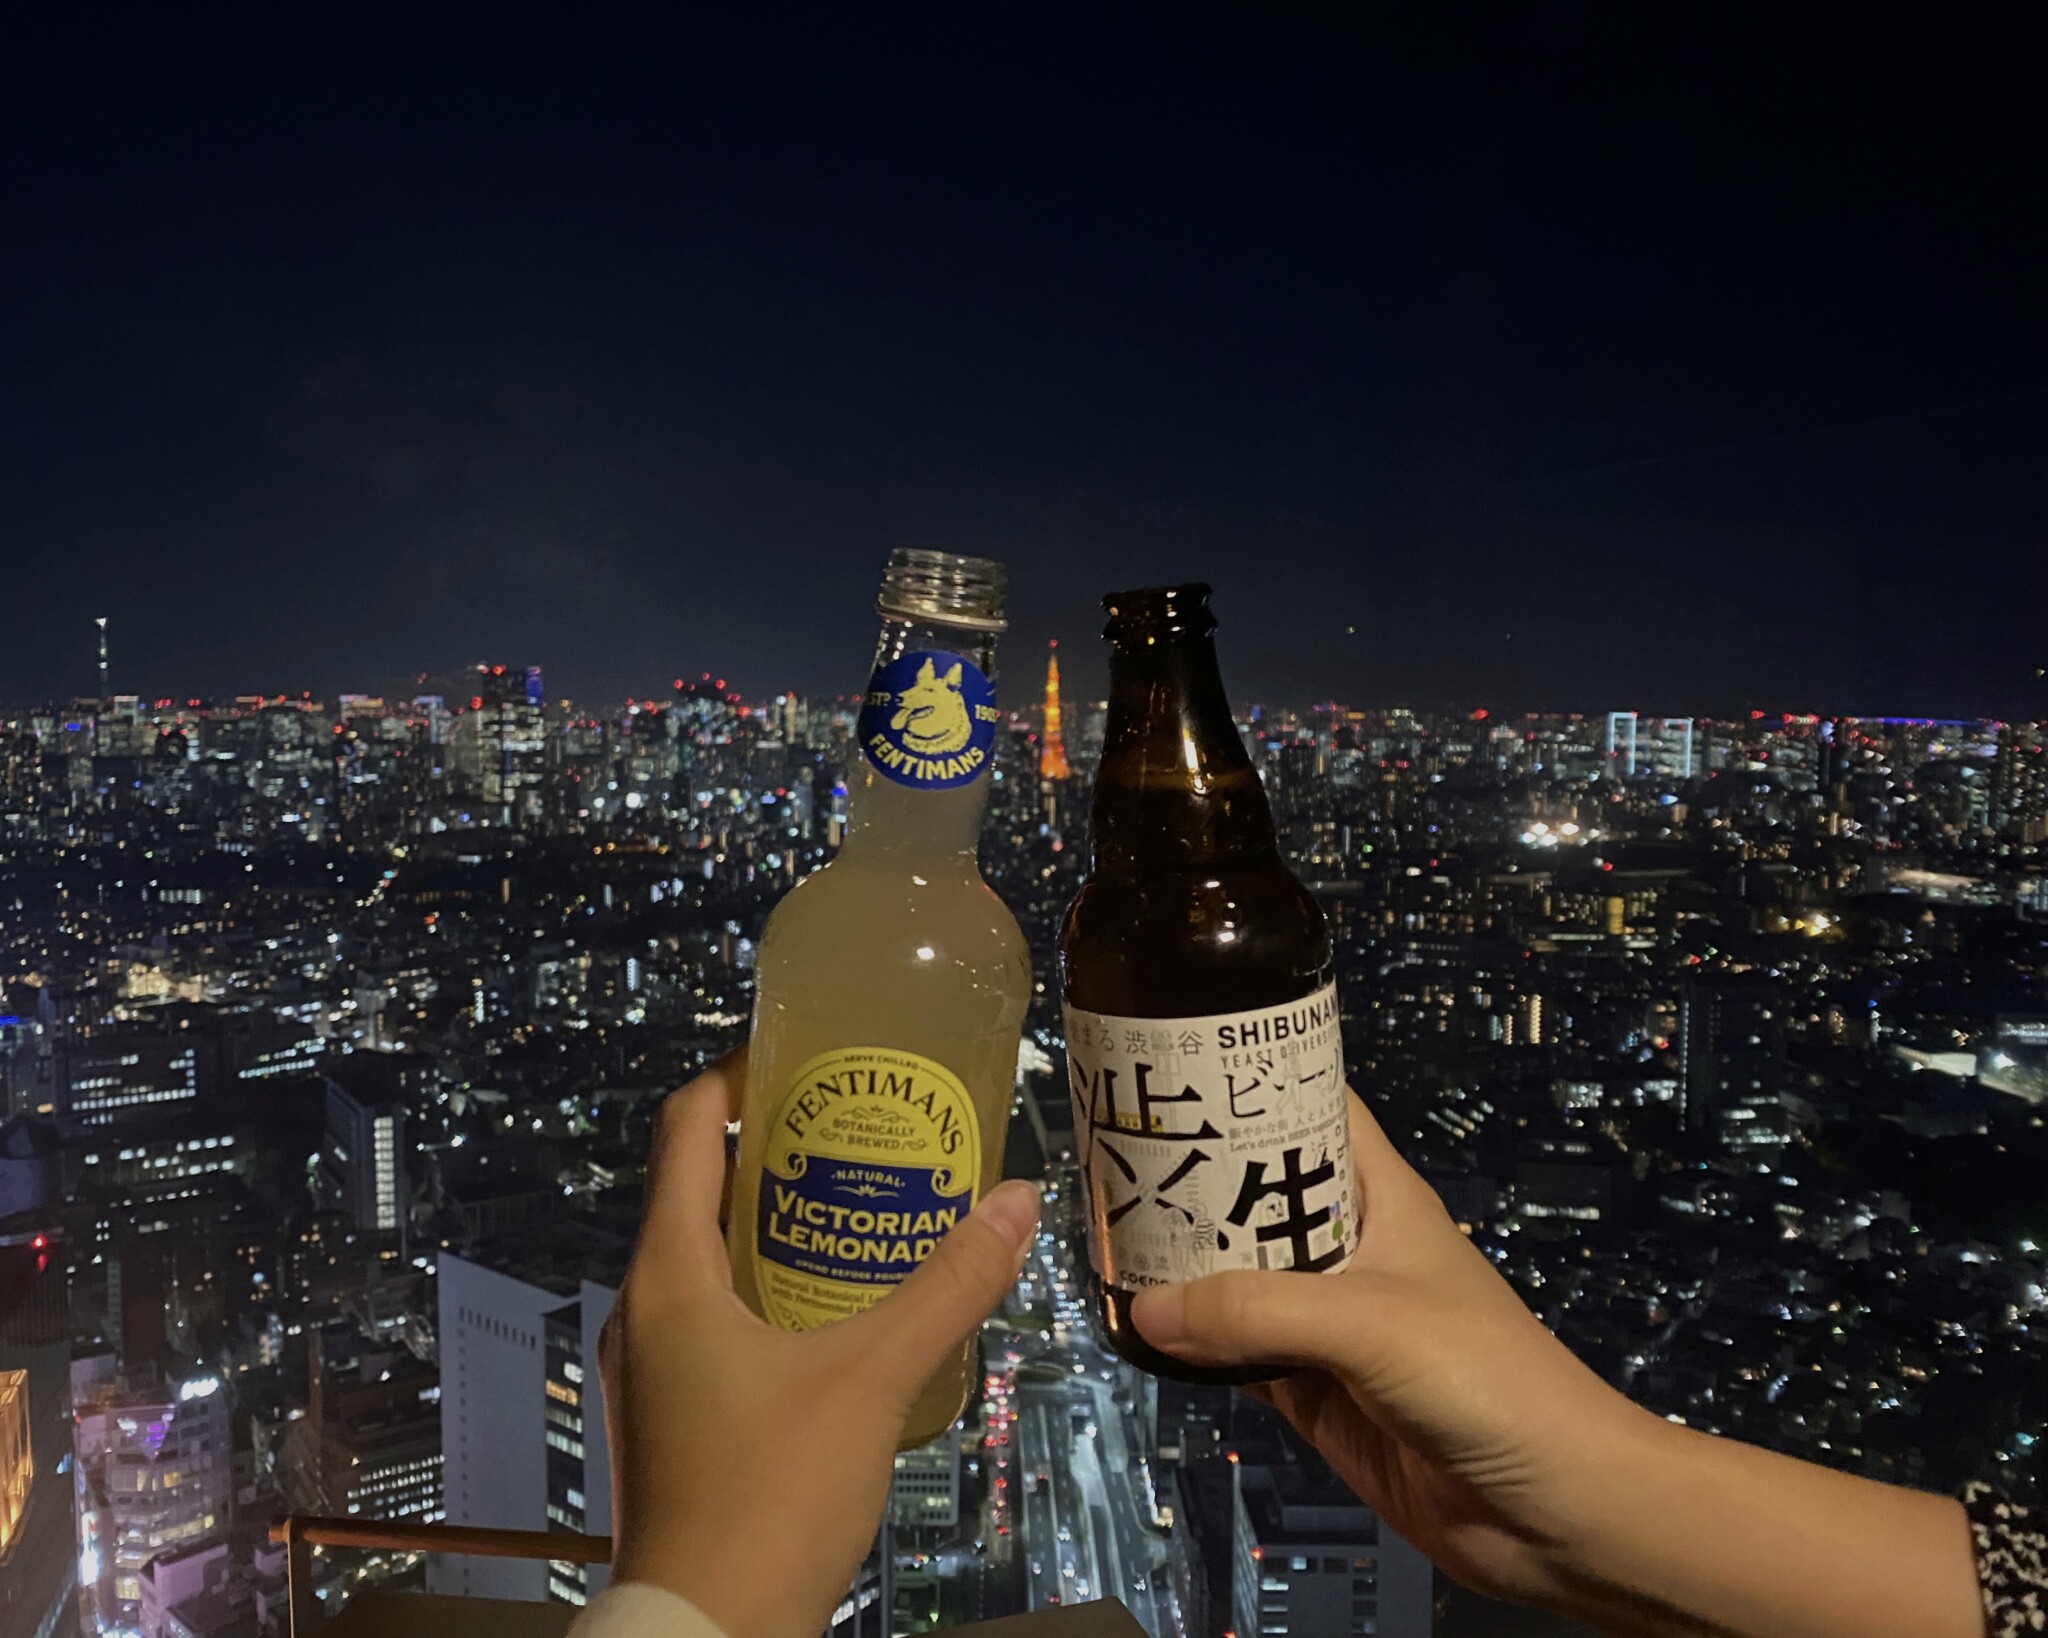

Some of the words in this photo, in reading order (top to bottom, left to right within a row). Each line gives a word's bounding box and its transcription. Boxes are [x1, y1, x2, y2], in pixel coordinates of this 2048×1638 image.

[869, 733, 985, 780] FENTIMANS
[1220, 1049, 1272, 1070] YEAST
[785, 1069, 964, 1155] FENTIMANS
[832, 1117, 916, 1137] BOTANICALLY
[847, 1131, 900, 1150] BREWED
[835, 1169, 902, 1188] NATURAL
[774, 1184, 957, 1236] VICTORIAN
[768, 1211, 941, 1263] LEMONAD
